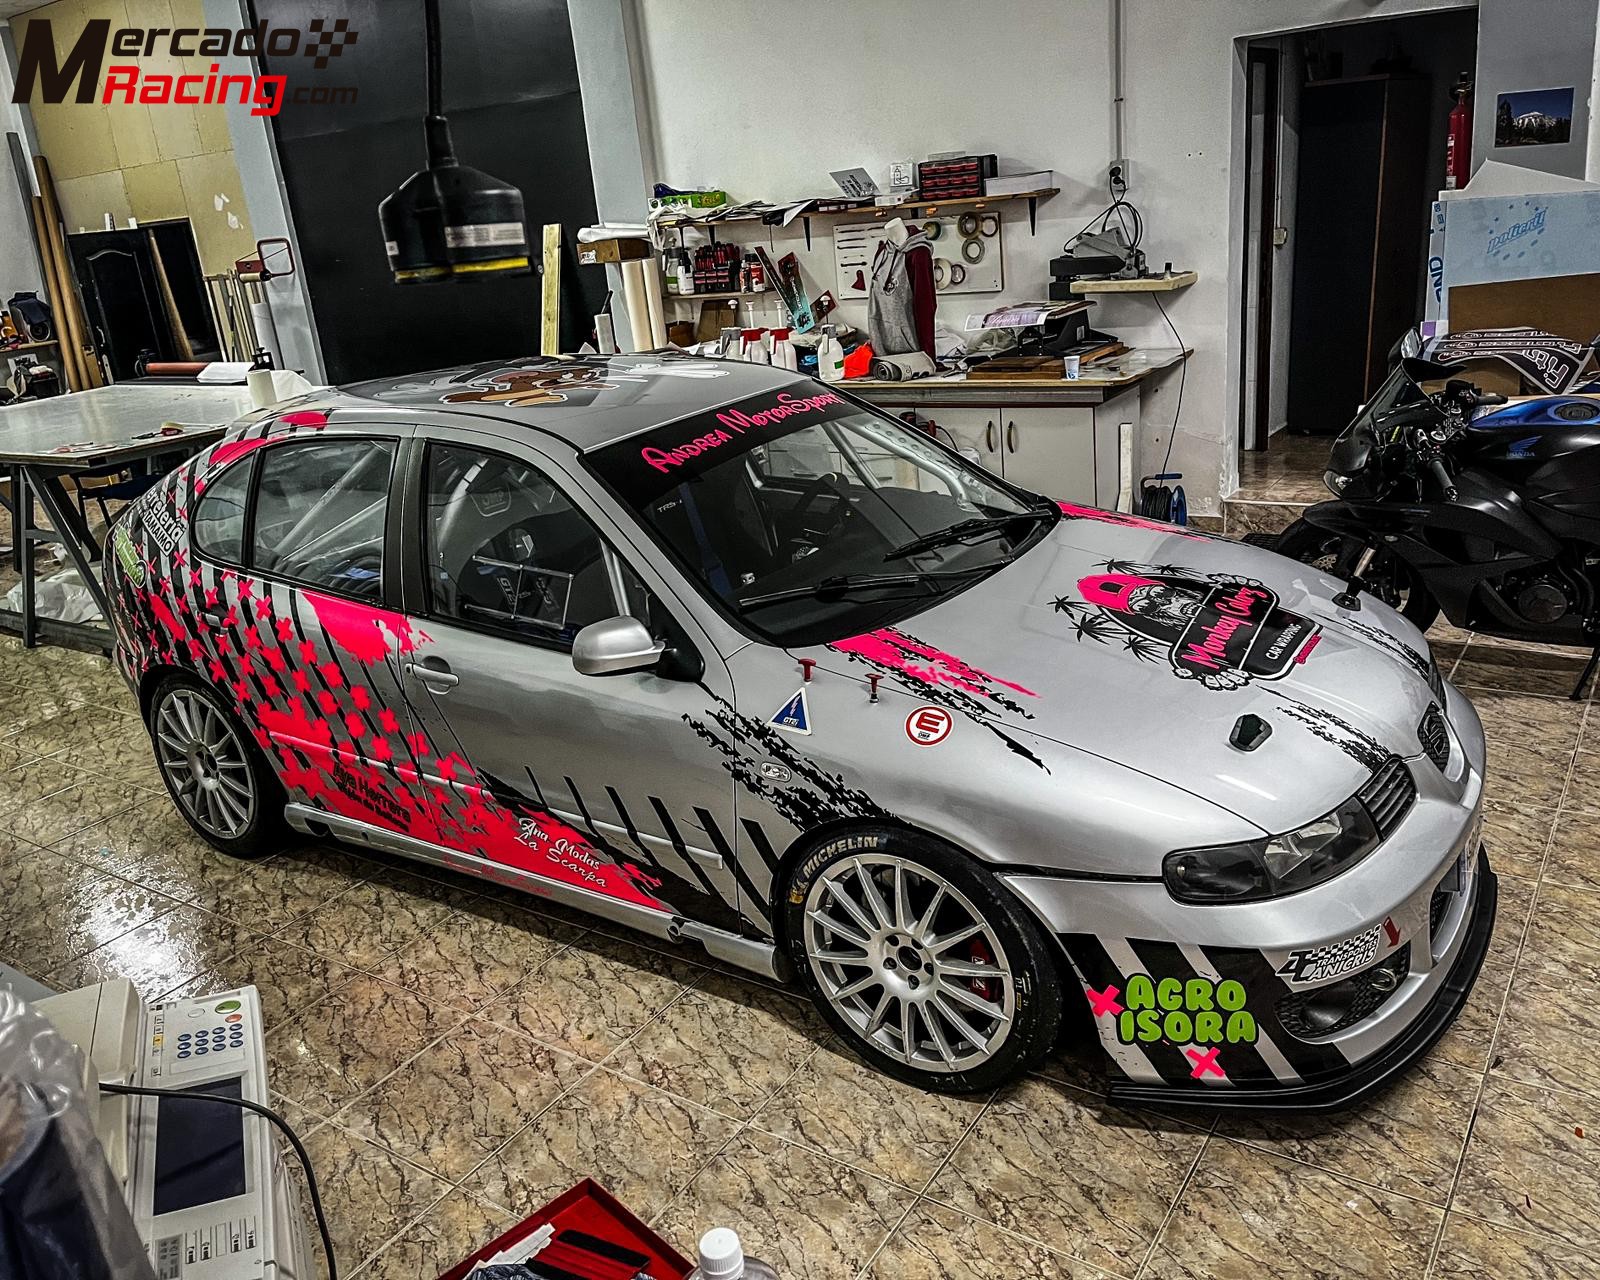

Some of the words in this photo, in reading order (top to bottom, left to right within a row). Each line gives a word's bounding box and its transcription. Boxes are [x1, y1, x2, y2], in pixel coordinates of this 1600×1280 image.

[1506, 449, 1536, 458] HONDA
[143, 510, 173, 552] TAMAIMO
[1181, 615, 1253, 669] Monkey
[1265, 646, 1282, 661] CAR
[1276, 622, 1302, 649] WRAPPING
[513, 832, 540, 852] La
[546, 847, 607, 888] Scarpa
[555, 838, 601, 870] Modas
[803, 836, 880, 877] MICHELIN
[1308, 947, 1377, 981] ANICRIS
[1316, 939, 1378, 967] TRANSPORTES
[1125, 974, 1247, 1012] AGRO
[1120, 1009, 1257, 1044] ISORA
